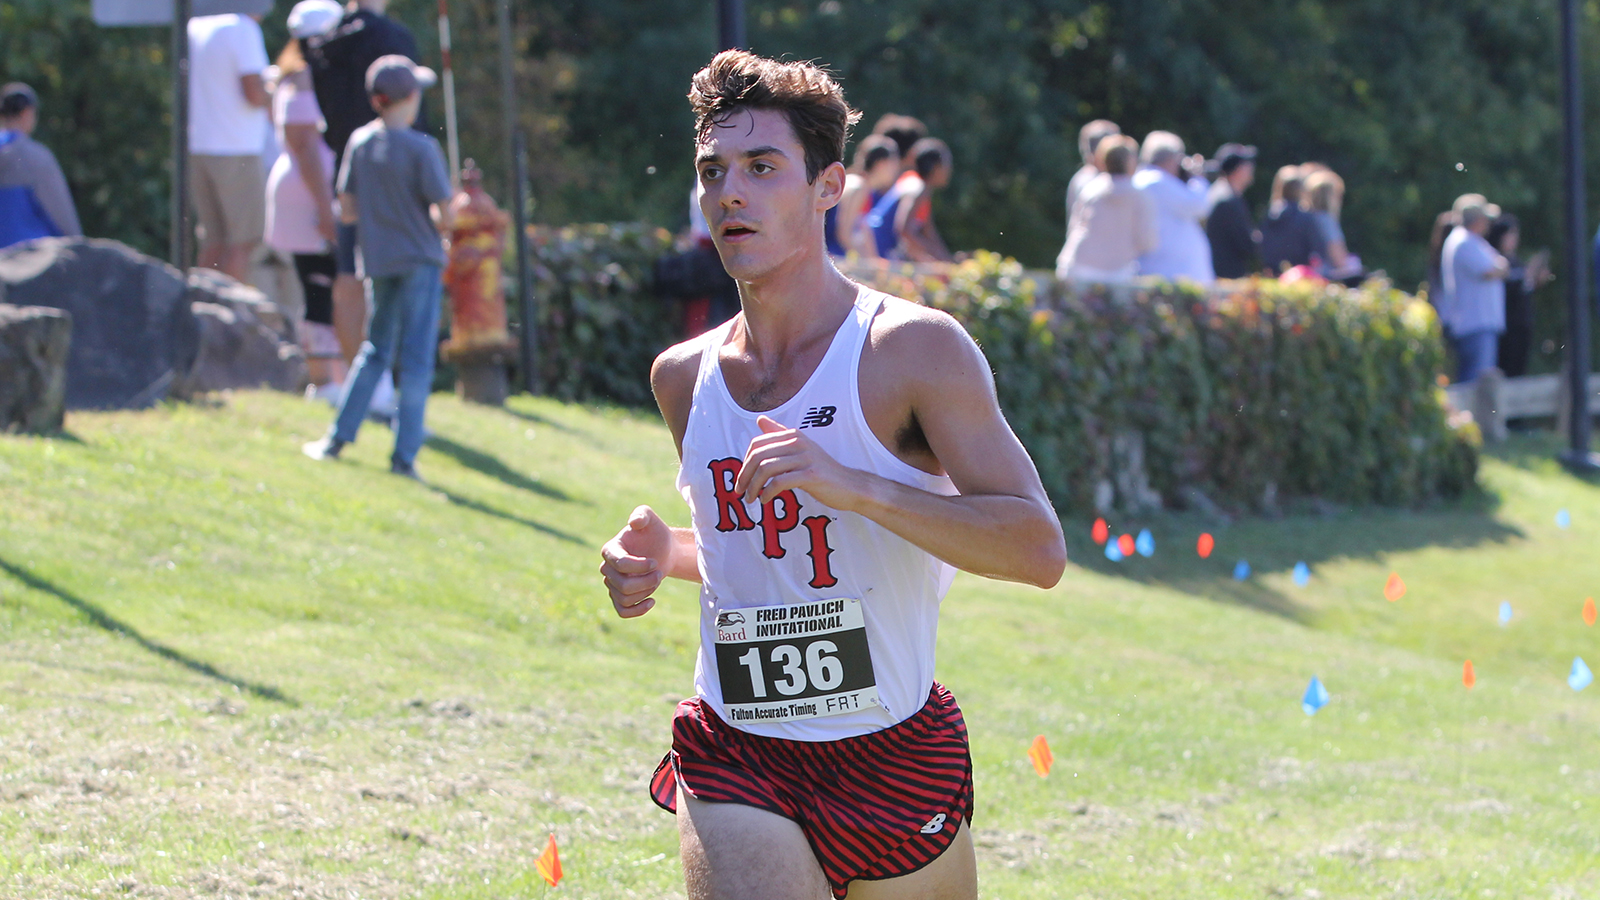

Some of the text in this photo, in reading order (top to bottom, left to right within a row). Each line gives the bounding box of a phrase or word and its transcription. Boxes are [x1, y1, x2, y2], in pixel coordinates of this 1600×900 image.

[756, 600, 844, 622] FRED PAVLICH
[718, 628, 747, 642] Bard
[756, 616, 843, 638] INVITATIONAL
[738, 640, 844, 698] 136
[731, 702, 817, 721] Fulton Accurate Timing
